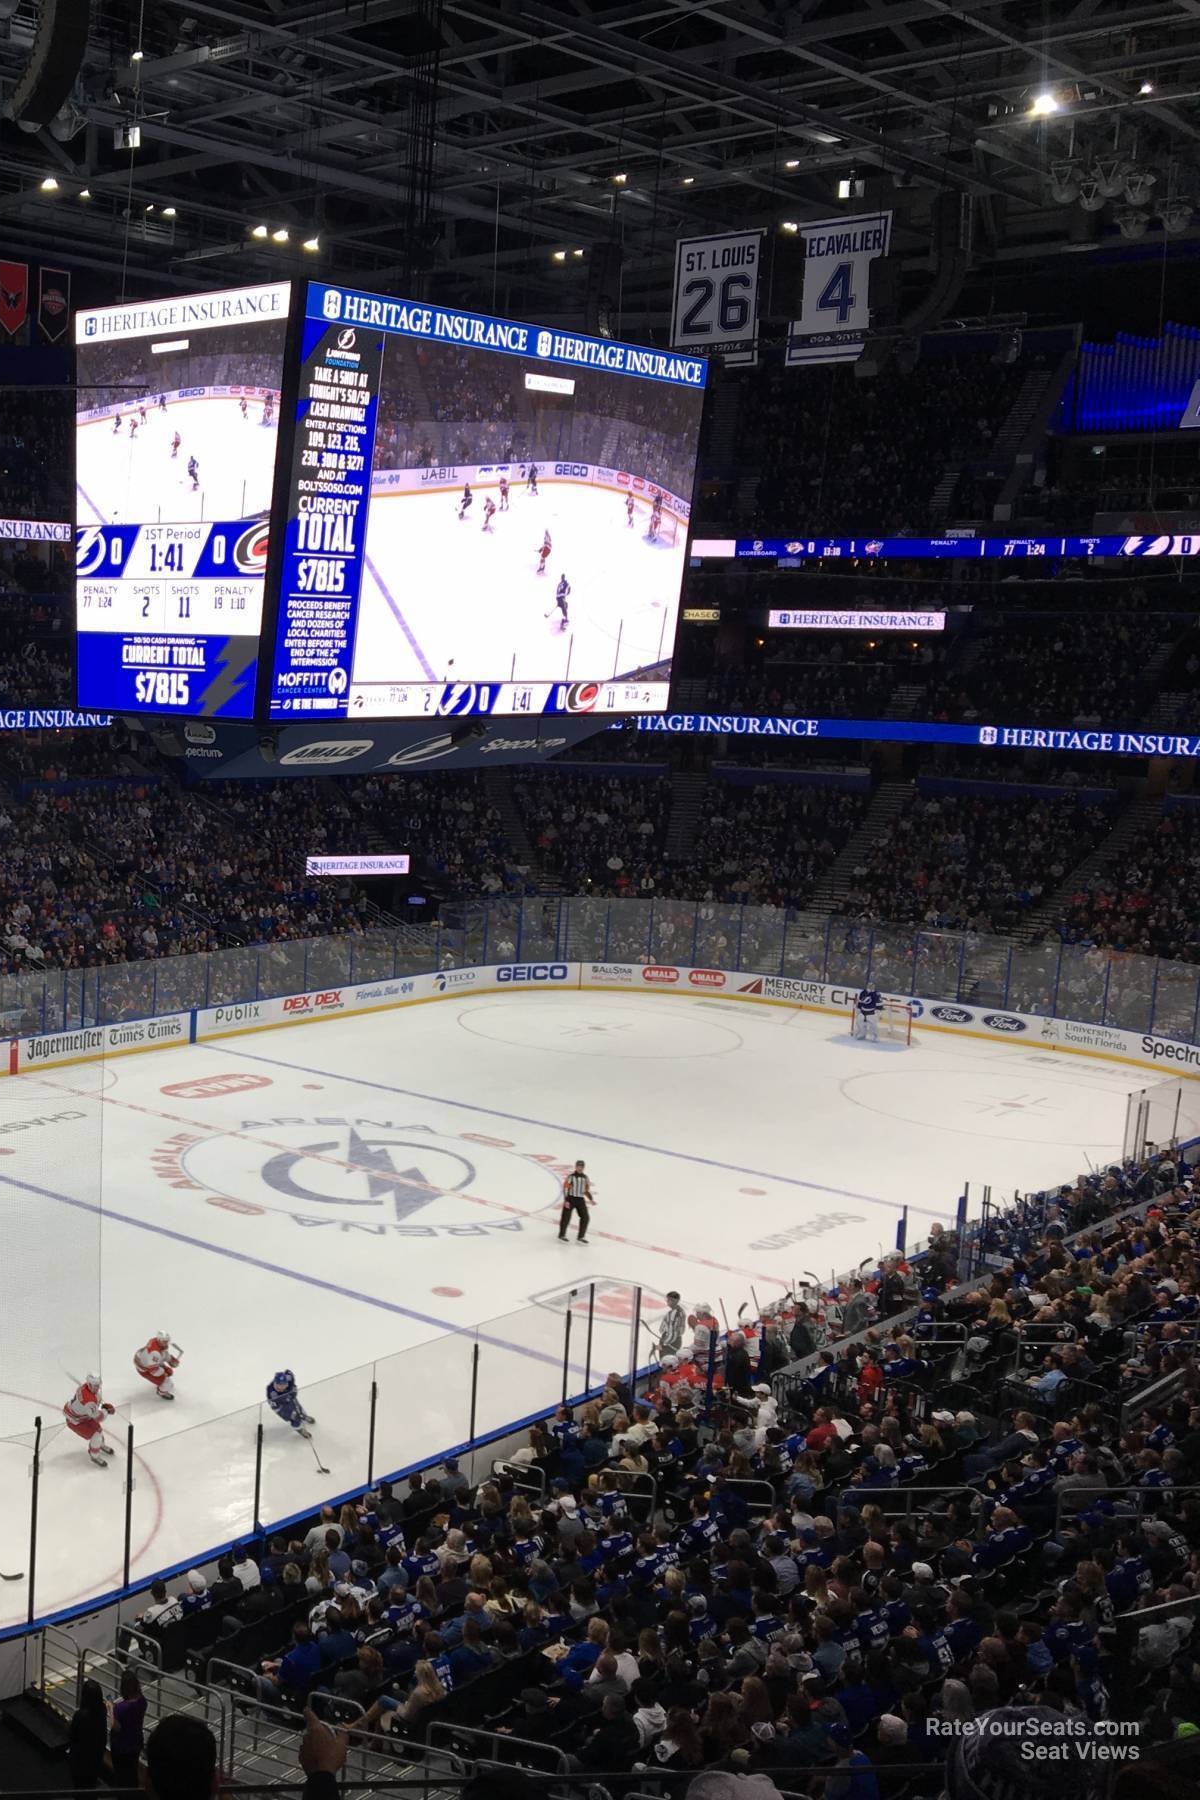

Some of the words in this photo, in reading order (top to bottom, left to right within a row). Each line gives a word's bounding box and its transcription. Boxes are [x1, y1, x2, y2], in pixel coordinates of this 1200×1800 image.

[804, 229, 884, 259] ECAVALIER
[685, 252, 707, 272] ST.
[711, 244, 756, 269] LOUIS
[816, 261, 856, 324] 4
[102, 307, 178, 333] HERITAGE
[182, 293, 281, 323] INSURANCE
[681, 272, 753, 337] 26
[343, 295, 431, 335] HERITAGE
[434, 312, 528, 351] INSURANCE
[553, 335, 626, 370] HERITAGE
[625, 351, 702, 383] INSURANCE
[314, 366, 332, 382] TAKE
[332, 369, 339, 384] A
[340, 371, 358, 387] SHOT
[358, 373, 368, 388] AT
[179, 388, 205, 398] GEICO
[309, 384, 347, 402] TONIGHT'S
[347, 387, 370, 406] 50/50
[310, 401, 330, 418] CASH
[329, 404, 366, 422] DRAWING!
[305, 419, 328, 430] ENTER
[327, 421, 336, 430] AT
[336, 422, 367, 435] SECTIONS
[308, 431, 326, 448] 109,
[328, 434, 344, 450] 123,
[344, 435, 361, 452] 215,
[317, 469, 336, 480] AND
[336, 471, 347, 481] AT
[421, 467, 458, 480] JABIL
[554, 464, 589, 477] GEICO
[298, 480, 363, 495] BOLTS5050.COM
[298, 495, 360, 516] CURRENT
[145, 528, 163, 541] 1ST
[166, 528, 201, 540] Period
[297, 512, 356, 552] TOTAL
[110, 537, 123, 566] 0
[212, 535, 226, 565] 0
[808, 541, 815, 554] 0
[1003, 544, 1014, 555] 77
[1026, 544, 1046, 555] 1:24
[1087, 544, 1094, 555] 2
[1181, 537, 1192, 554] 0
[150, 543, 184, 572] 1:41
[297, 559, 346, 592] $7815
[83, 586, 118, 594] PENALTY
[133, 587, 160, 595] SHOTS
[171, 587, 200, 595] SHOTS
[214, 586, 254, 594] PENALTY
[83, 596, 92, 608] 77
[98, 596, 112, 608] 1:24
[142, 596, 150, 617] 2
[179, 597, 190, 618] 11
[214, 597, 223, 609] 19
[230, 597, 245, 610] 1:10
[287, 600, 324, 610] PROCEEDS
[324, 601, 352, 611] BENEFIT
[287, 609, 315, 619] CANCER
[315, 611, 351, 620] RESEARCH
[792, 613, 856, 625] HERITAGE
[858, 614, 935, 626] INSURANCE
[290, 619, 306, 628] AND
[307, 619, 334, 629] DOZENS
[335, 620, 345, 629] OF
[287, 628, 310, 638] LOCAL
[310, 629, 347, 638] CHARITIES!
[284, 639, 307, 648] ENTER
[307, 639, 333, 648] BEFORE
[333, 639, 348, 649] THE
[122, 645, 171, 665] CURRENT
[172, 646, 206, 666] TOTAL
[290, 648, 304, 657] END
[305, 648, 316, 657] OF
[316, 648, 330, 658] THE
[290, 658, 339, 667] INTERMISSION
[277, 672, 329, 687] MOFFITT
[135, 672, 189, 706] $7815
[424, 693, 431, 712] 2
[478, 686, 490, 711] 0
[512, 692, 531, 712] 1:41
[556, 686, 567, 710] 0
[607, 691, 615, 708] 11
[28, 710, 114, 728] INSURANCE
[698, 716, 819, 736] INSURANCE
[480, 738, 566, 753] Spectrum
[1002, 729, 1113, 751] HERITAGE
[321, 861, 358, 870] HERITAGE
[360, 860, 405, 869] INSURANCE
[448, 972, 476, 983] TECO
[496, 965, 568, 982] GEICO
[644, 967, 679, 979] AMALIE
[691, 971, 724, 983] AMALIE
[356, 989, 383, 1000] Florida
[384, 986, 400, 997] Blue
[765, 977, 826, 995] MERCURY
[283, 996, 310, 1011] DEX
[314, 991, 341, 1005] DEX
[764, 988, 826, 1005] INSURANCE
[215, 1003, 260, 1023] Publix
[289, 1007, 314, 1016] imaging
[321, 1002, 345, 1011] imaging
[937, 1007, 965, 1021] Ford
[148, 1022, 182, 1039] Times
[990, 1016, 1020, 1031] Ford
[1064, 1023, 1114, 1039] University
[110, 1029, 145, 1045] Times
[1064, 1031, 1093, 1045] South
[1095, 1038, 1128, 1052] Florida
[241, 1117, 438, 1135] ARENA
[149, 1133, 206, 1190] AMALIE
[291, 1213, 524, 1237] ARENA
